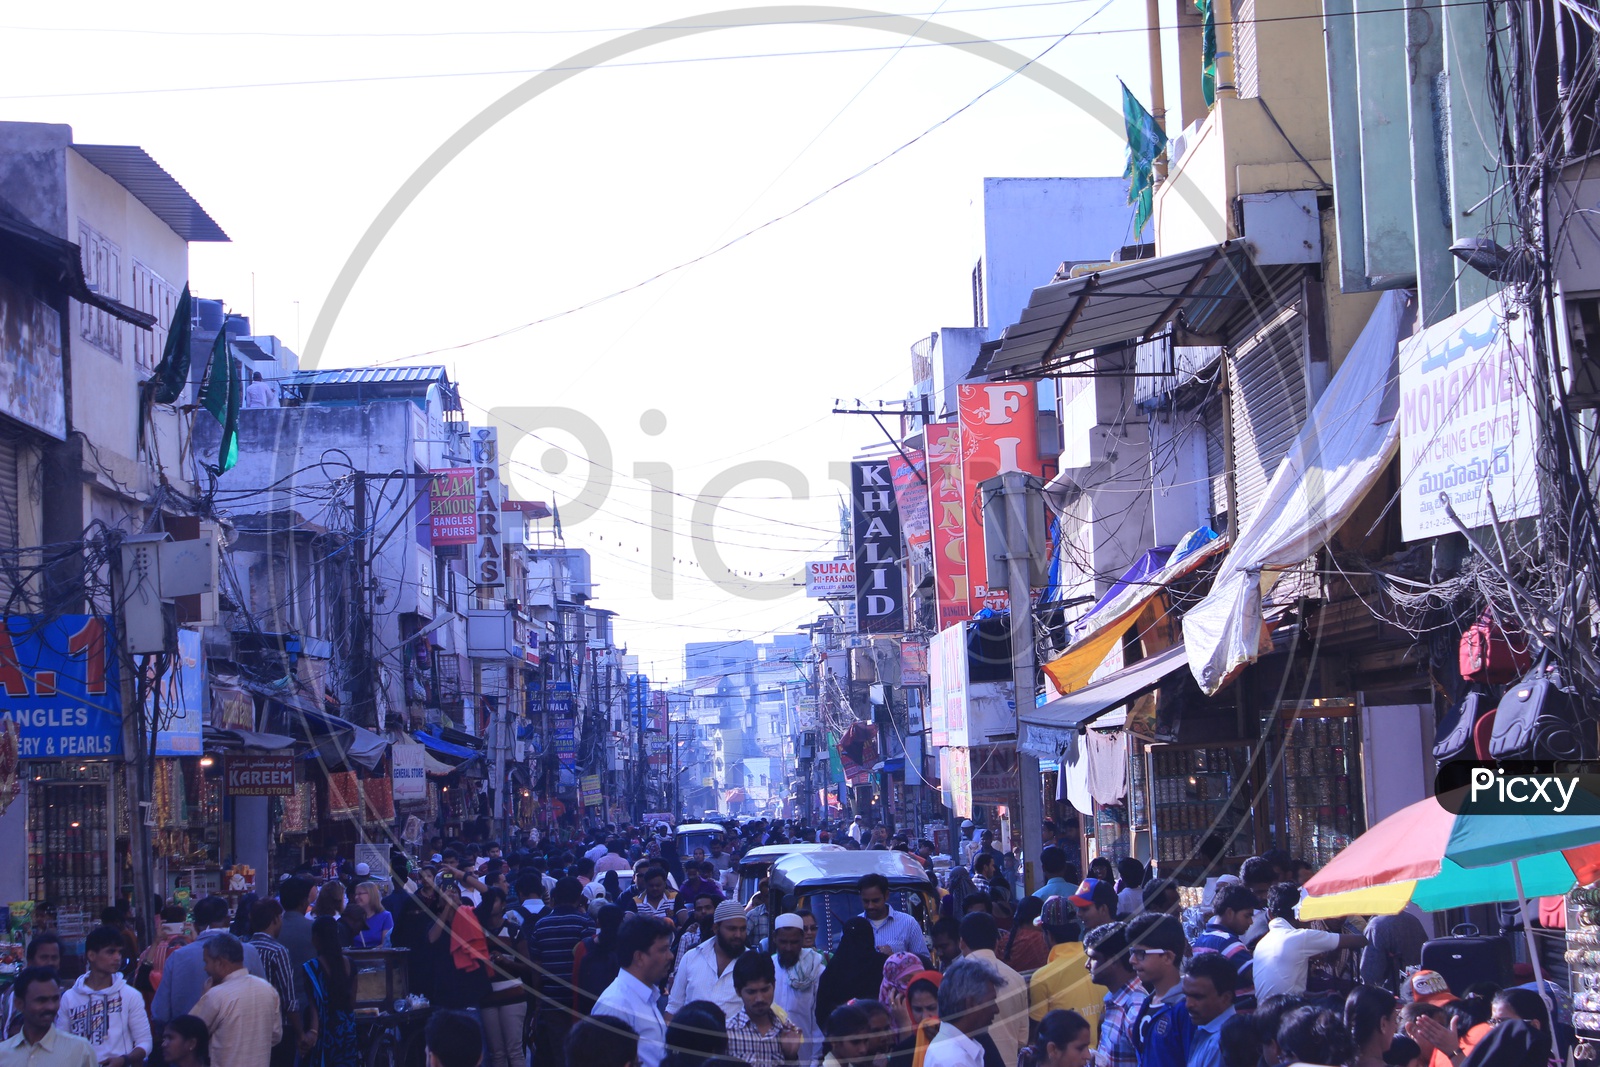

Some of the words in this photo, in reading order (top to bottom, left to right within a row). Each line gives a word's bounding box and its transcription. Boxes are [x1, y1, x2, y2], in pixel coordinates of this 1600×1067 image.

[1411, 429, 1467, 468] MATCHING
[1469, 411, 1520, 449] CENTRE
[430, 476, 475, 497] AZAM
[431, 499, 475, 516] FAMOUS
[434, 516, 473, 526] BANGLES
[433, 529, 439, 537] &
[442, 527, 475, 537] PURSES
[860, 465, 895, 617] KHALID
[45, 738, 55, 755] &
[60, 735, 112, 755] PEARLS
[229, 770, 292, 787] KAREEM
[393, 768, 410, 779] GENERAL
[411, 767, 424, 778] STORE
[229, 787, 265, 795] BANGLES
[266, 787, 292, 795] STORE
